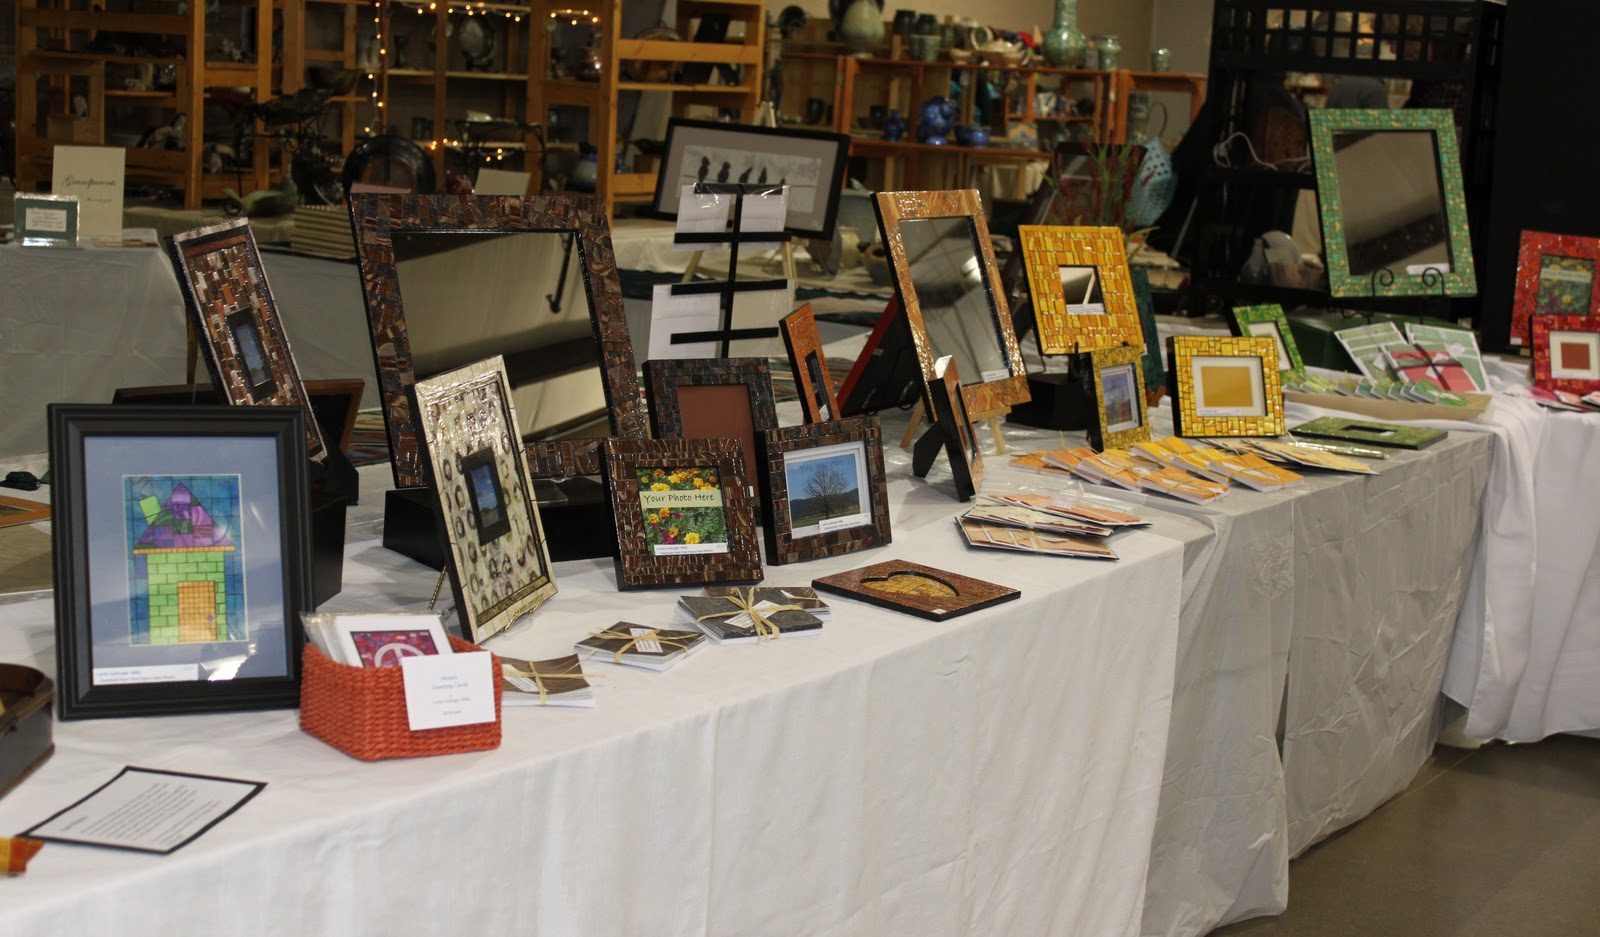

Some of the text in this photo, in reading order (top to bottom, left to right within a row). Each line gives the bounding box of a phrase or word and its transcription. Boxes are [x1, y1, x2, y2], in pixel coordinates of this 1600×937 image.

[643, 493, 714, 505] Your Photo Here
